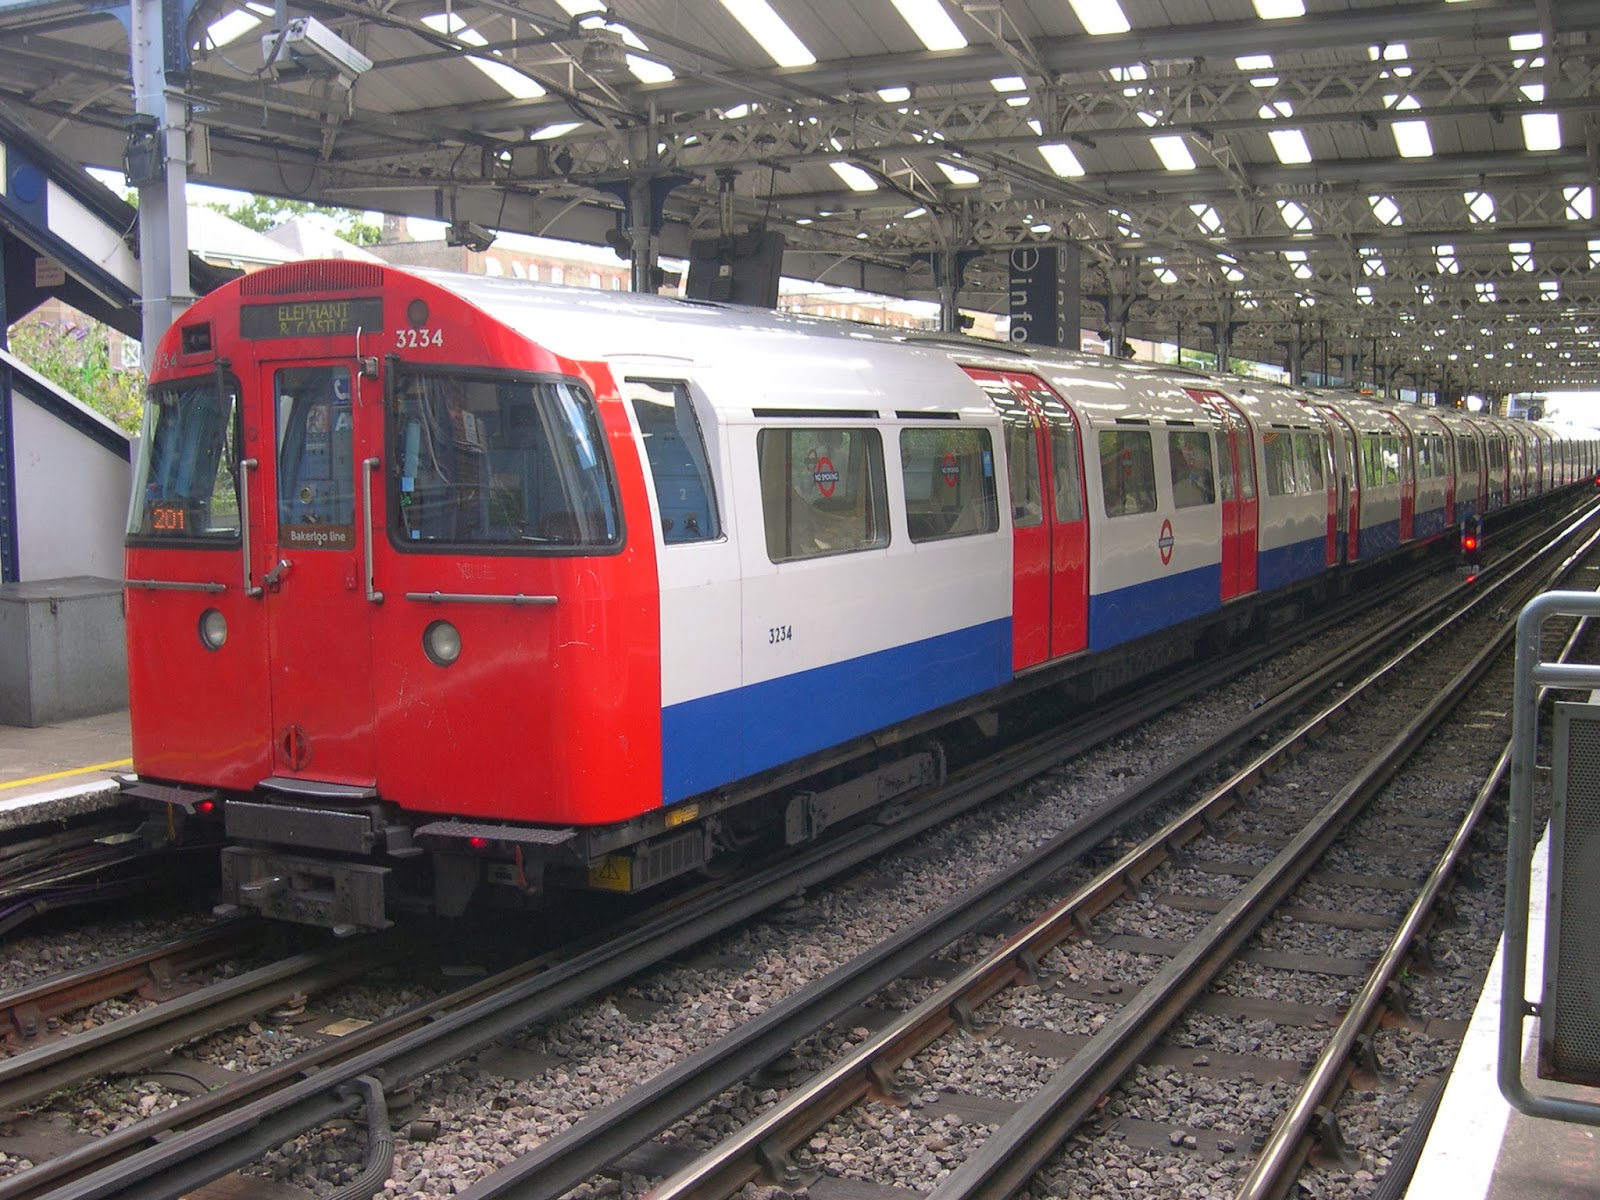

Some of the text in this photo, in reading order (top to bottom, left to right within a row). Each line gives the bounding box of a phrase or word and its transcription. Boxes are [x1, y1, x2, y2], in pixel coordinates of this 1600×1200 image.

[278, 303, 349, 321] ELEPHANT
[1011, 278, 1033, 342] info
[279, 322, 288, 335] &
[396, 328, 443, 348] 3234
[680, 488, 687, 500] 2
[153, 508, 184, 530] 201
[290, 530, 346, 541] Bakerloo line
[769, 625, 792, 644] 3234
